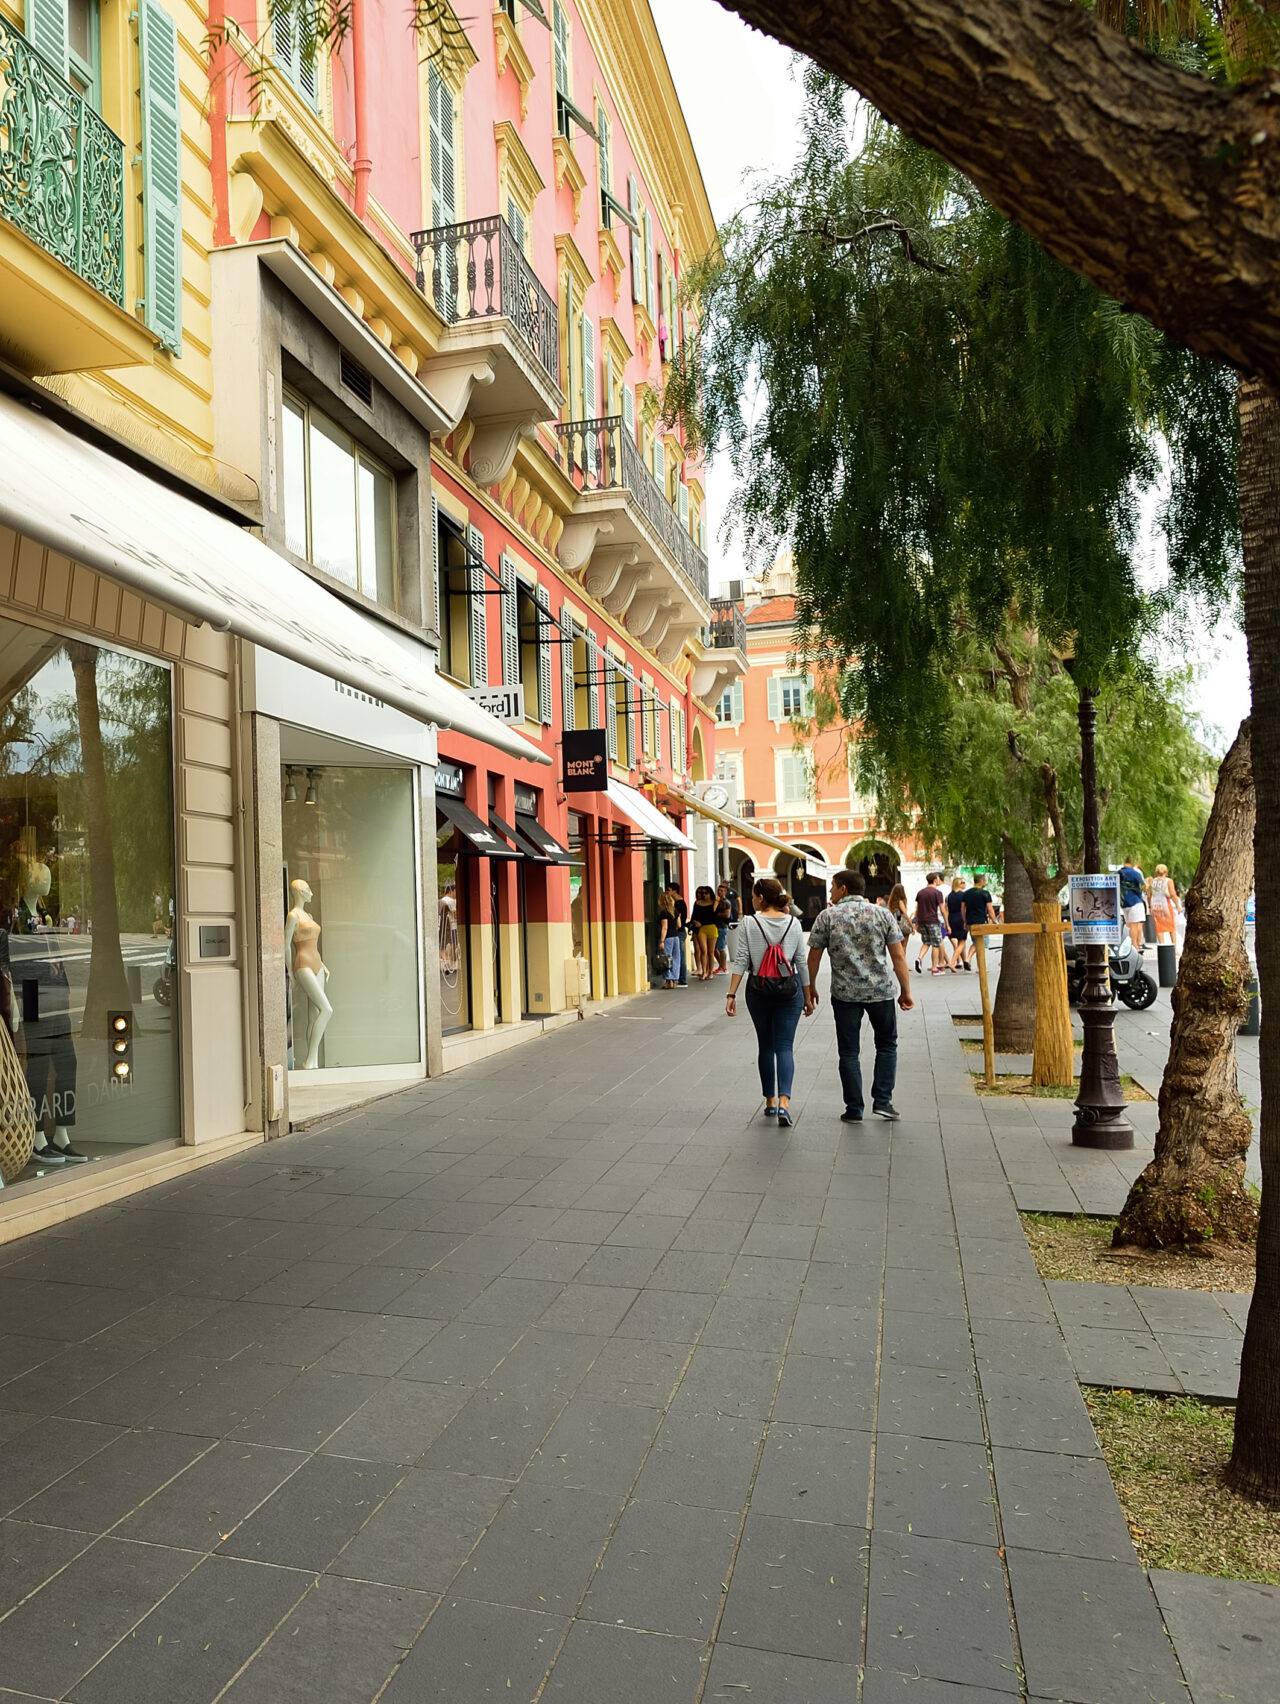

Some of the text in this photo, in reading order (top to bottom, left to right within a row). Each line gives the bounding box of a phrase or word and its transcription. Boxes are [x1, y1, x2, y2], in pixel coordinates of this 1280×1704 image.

[567, 760, 595, 769] MONT
[567, 768, 595, 776] BLANC
[1, 1071, 136, 1128] GERARD DAREL
